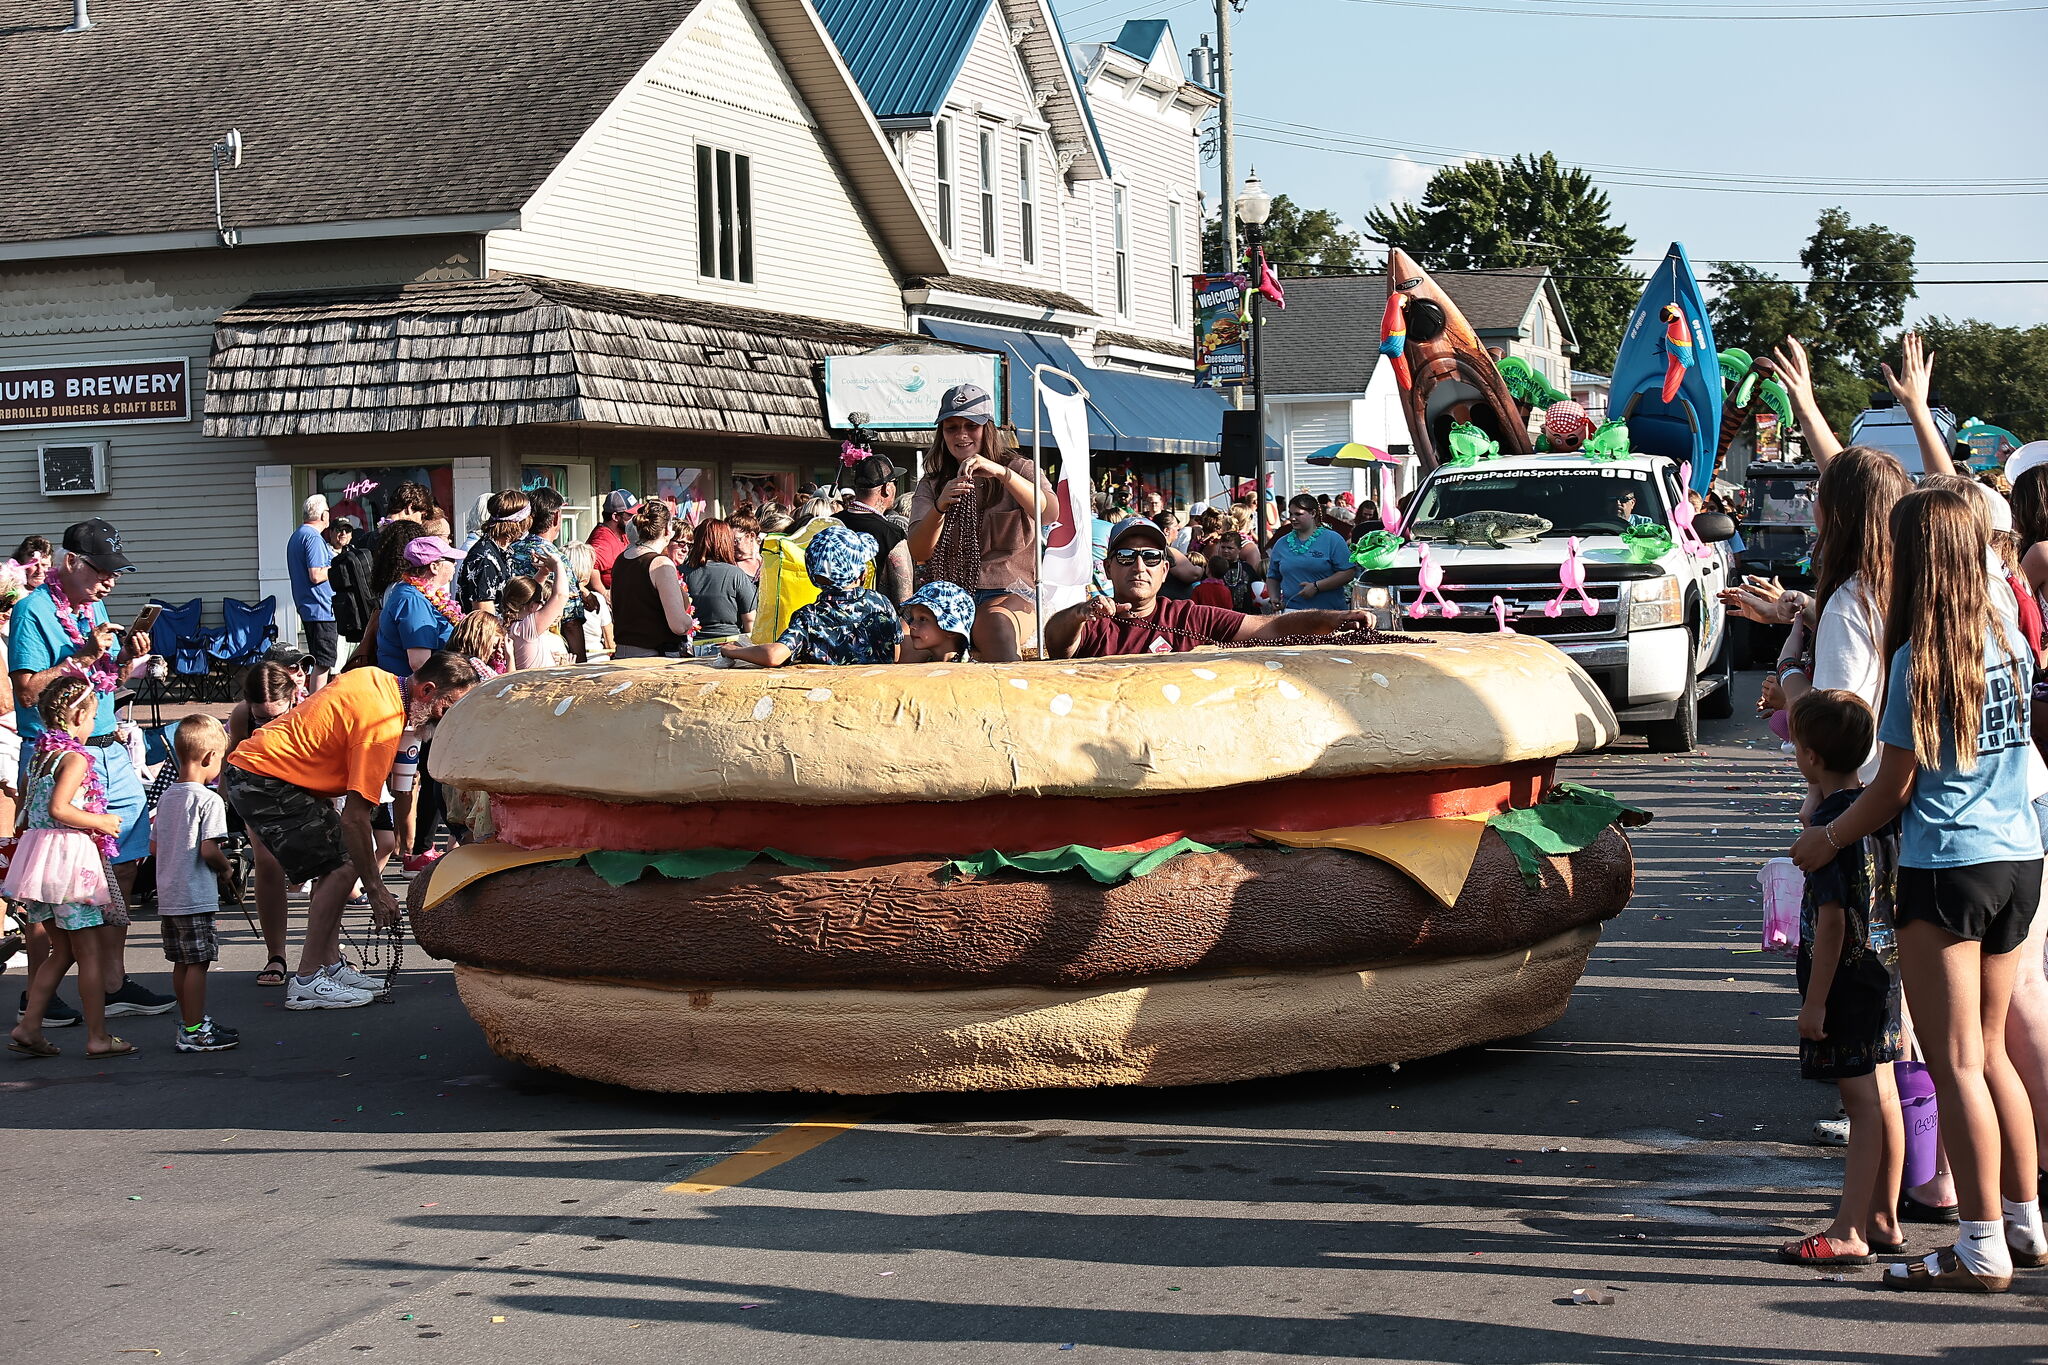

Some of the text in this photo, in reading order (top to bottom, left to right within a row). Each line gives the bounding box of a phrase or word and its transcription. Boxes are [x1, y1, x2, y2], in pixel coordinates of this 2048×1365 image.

[1198, 286, 1239, 308] Welcome
[1227, 301, 1235, 311] to
[1204, 354, 1245, 363] Cheeseburger
[1218, 364, 1245, 374] Caseville
[0, 373, 182, 400] UMB BREWERY
[52, 404, 99, 416] BURGERS
[102, 402, 111, 414] &
[114, 402, 147, 414] CRAFT
[150, 400, 177, 411] BEER
[1434, 469, 1599, 486] BullFrogsPaddleSports.com
